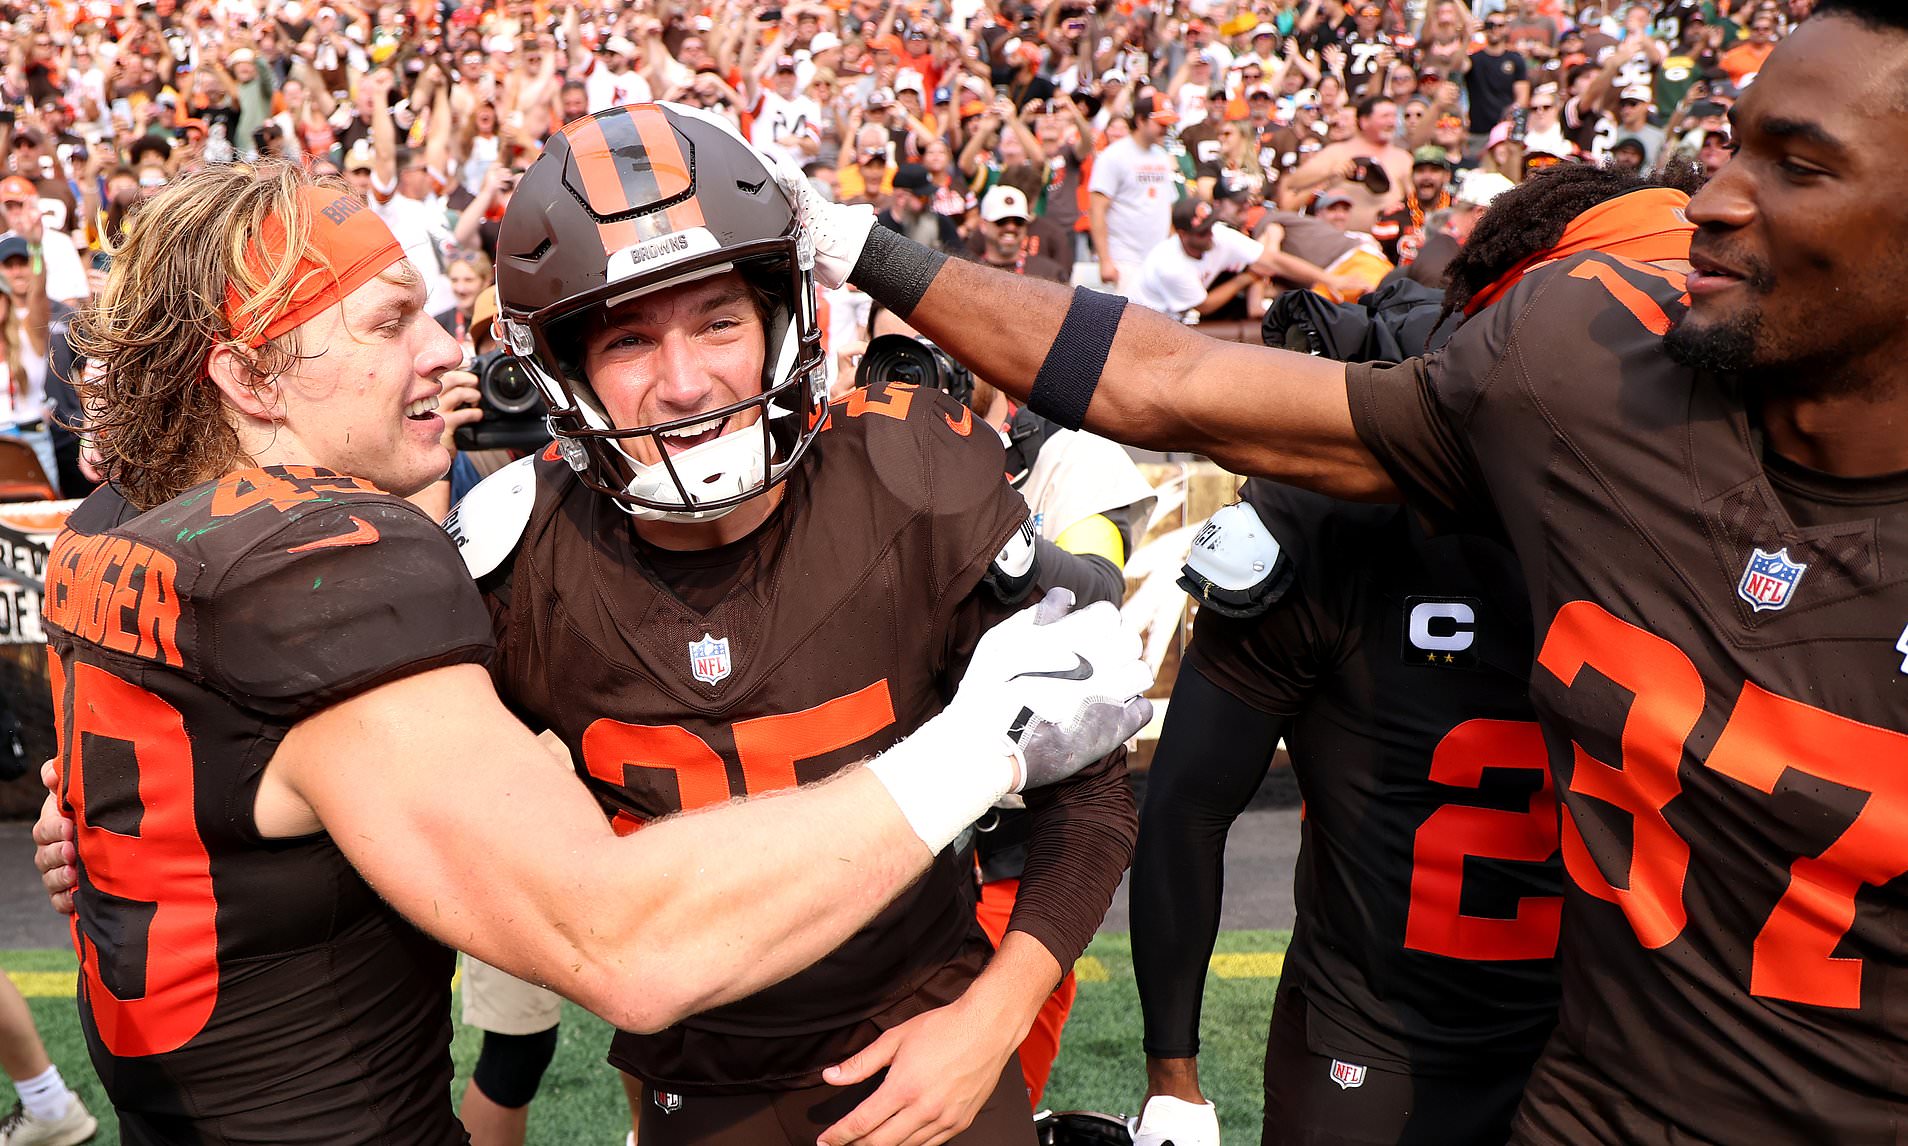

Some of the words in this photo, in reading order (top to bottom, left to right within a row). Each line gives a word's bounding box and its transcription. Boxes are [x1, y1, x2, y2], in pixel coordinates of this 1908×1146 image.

[630, 234, 689, 265] BROWNS
[1745, 573, 1783, 602] NFL
[1409, 602, 1475, 651] C
[696, 656, 726, 677] NFL
[1536, 599, 1908, 1010] 37
[1403, 717, 1564, 961] 2
[1335, 1063, 1359, 1082] NFL
[658, 1090, 679, 1107] NFL
